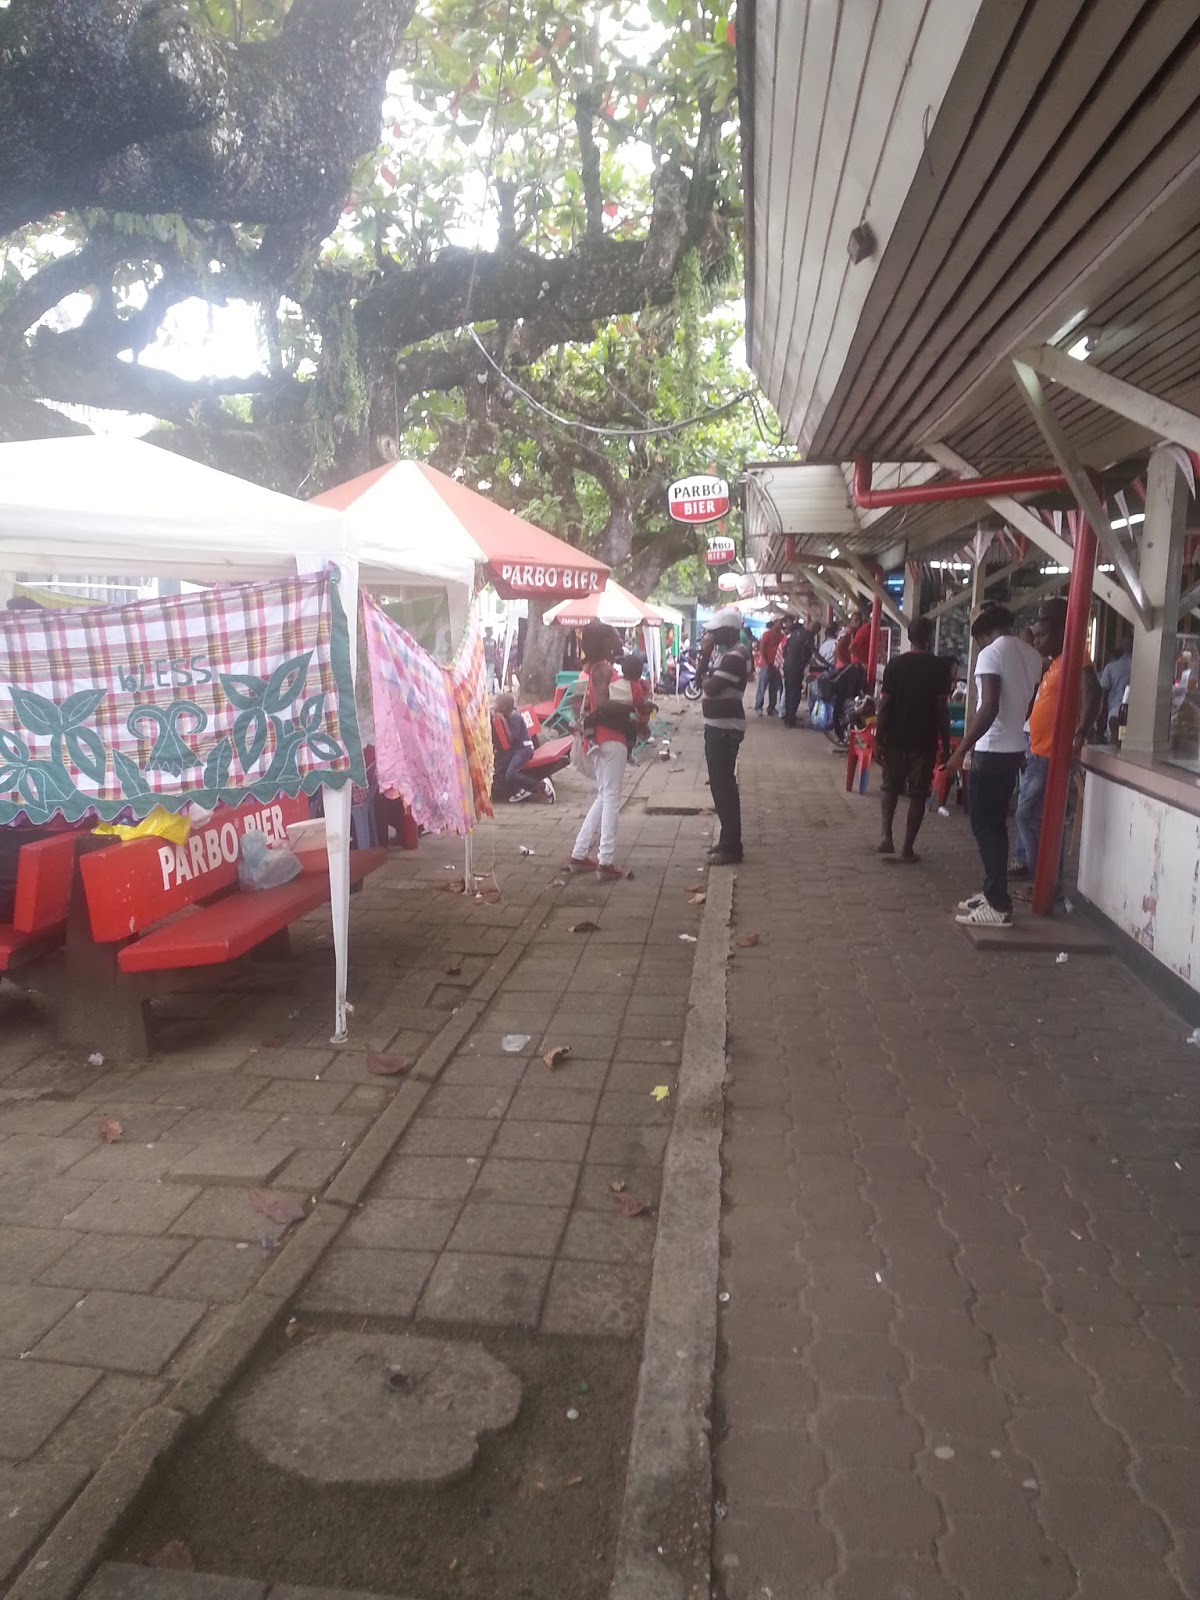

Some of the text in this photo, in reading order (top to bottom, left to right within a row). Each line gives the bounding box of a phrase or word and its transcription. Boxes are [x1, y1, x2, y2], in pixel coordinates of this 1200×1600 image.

[674, 483, 722, 499] PARBO
[684, 500, 715, 515] BIER
[705, 542, 731, 550] ARBO
[502, 564, 599, 590] PARBO BIER
[158, 822, 239, 891] PARBO
